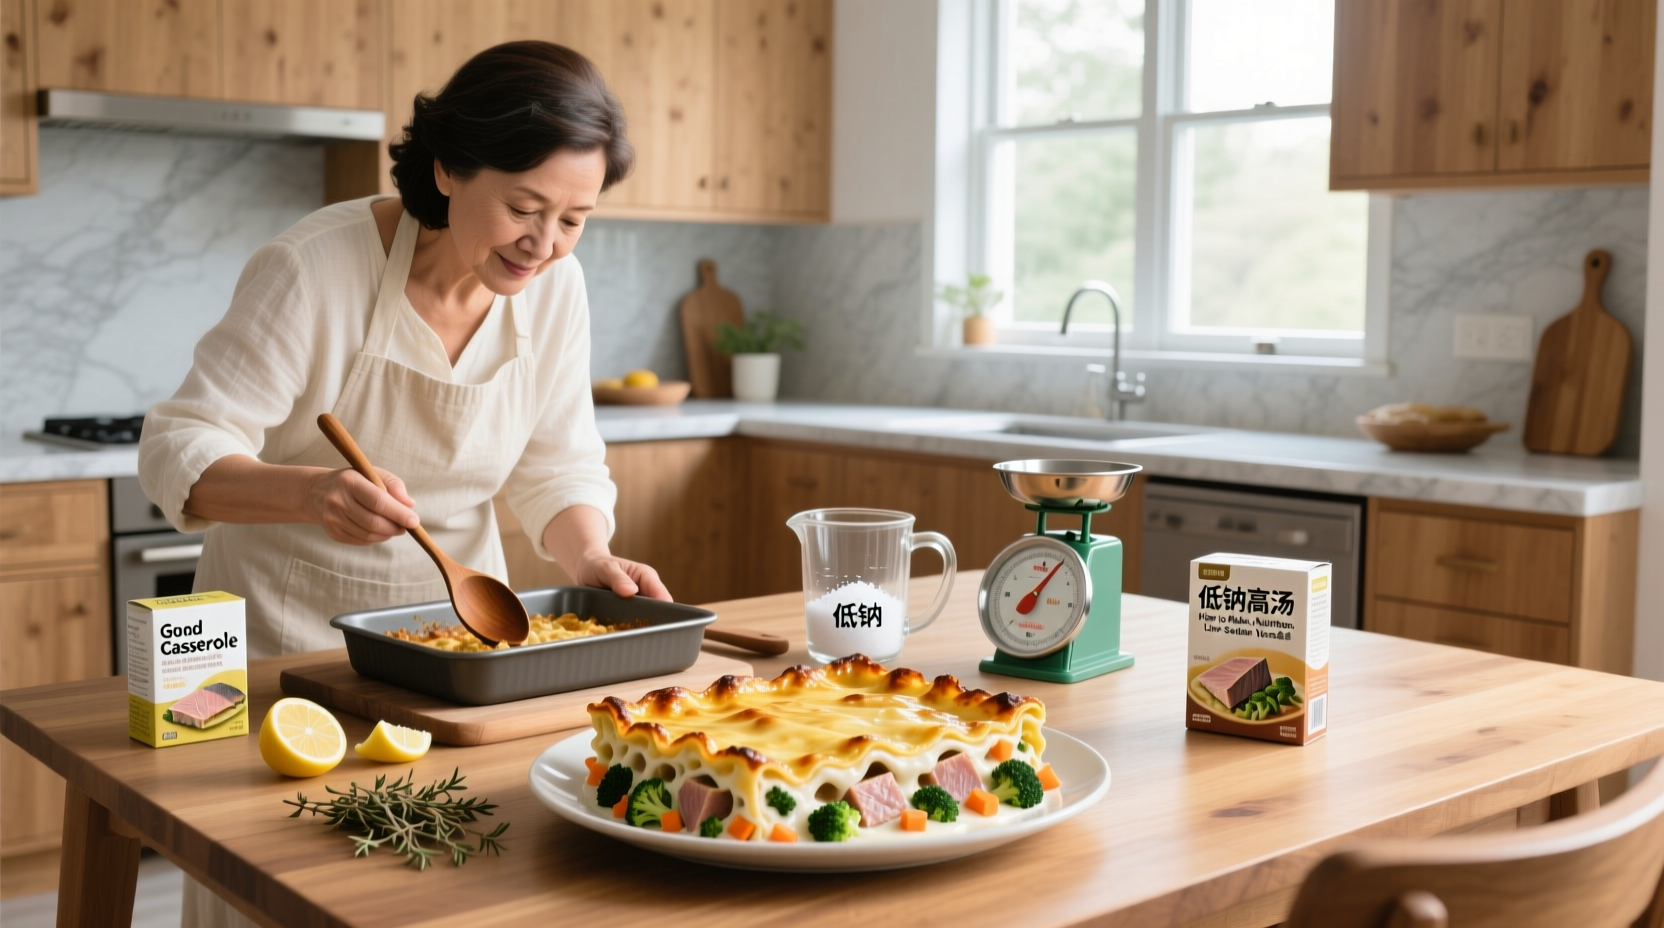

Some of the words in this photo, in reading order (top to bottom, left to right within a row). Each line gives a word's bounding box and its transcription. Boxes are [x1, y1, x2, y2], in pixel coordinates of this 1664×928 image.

[1199, 584, 1295, 616] 低钠高汤
[833, 602, 882, 628] 低钠
[160, 631, 239, 656] Casserole
